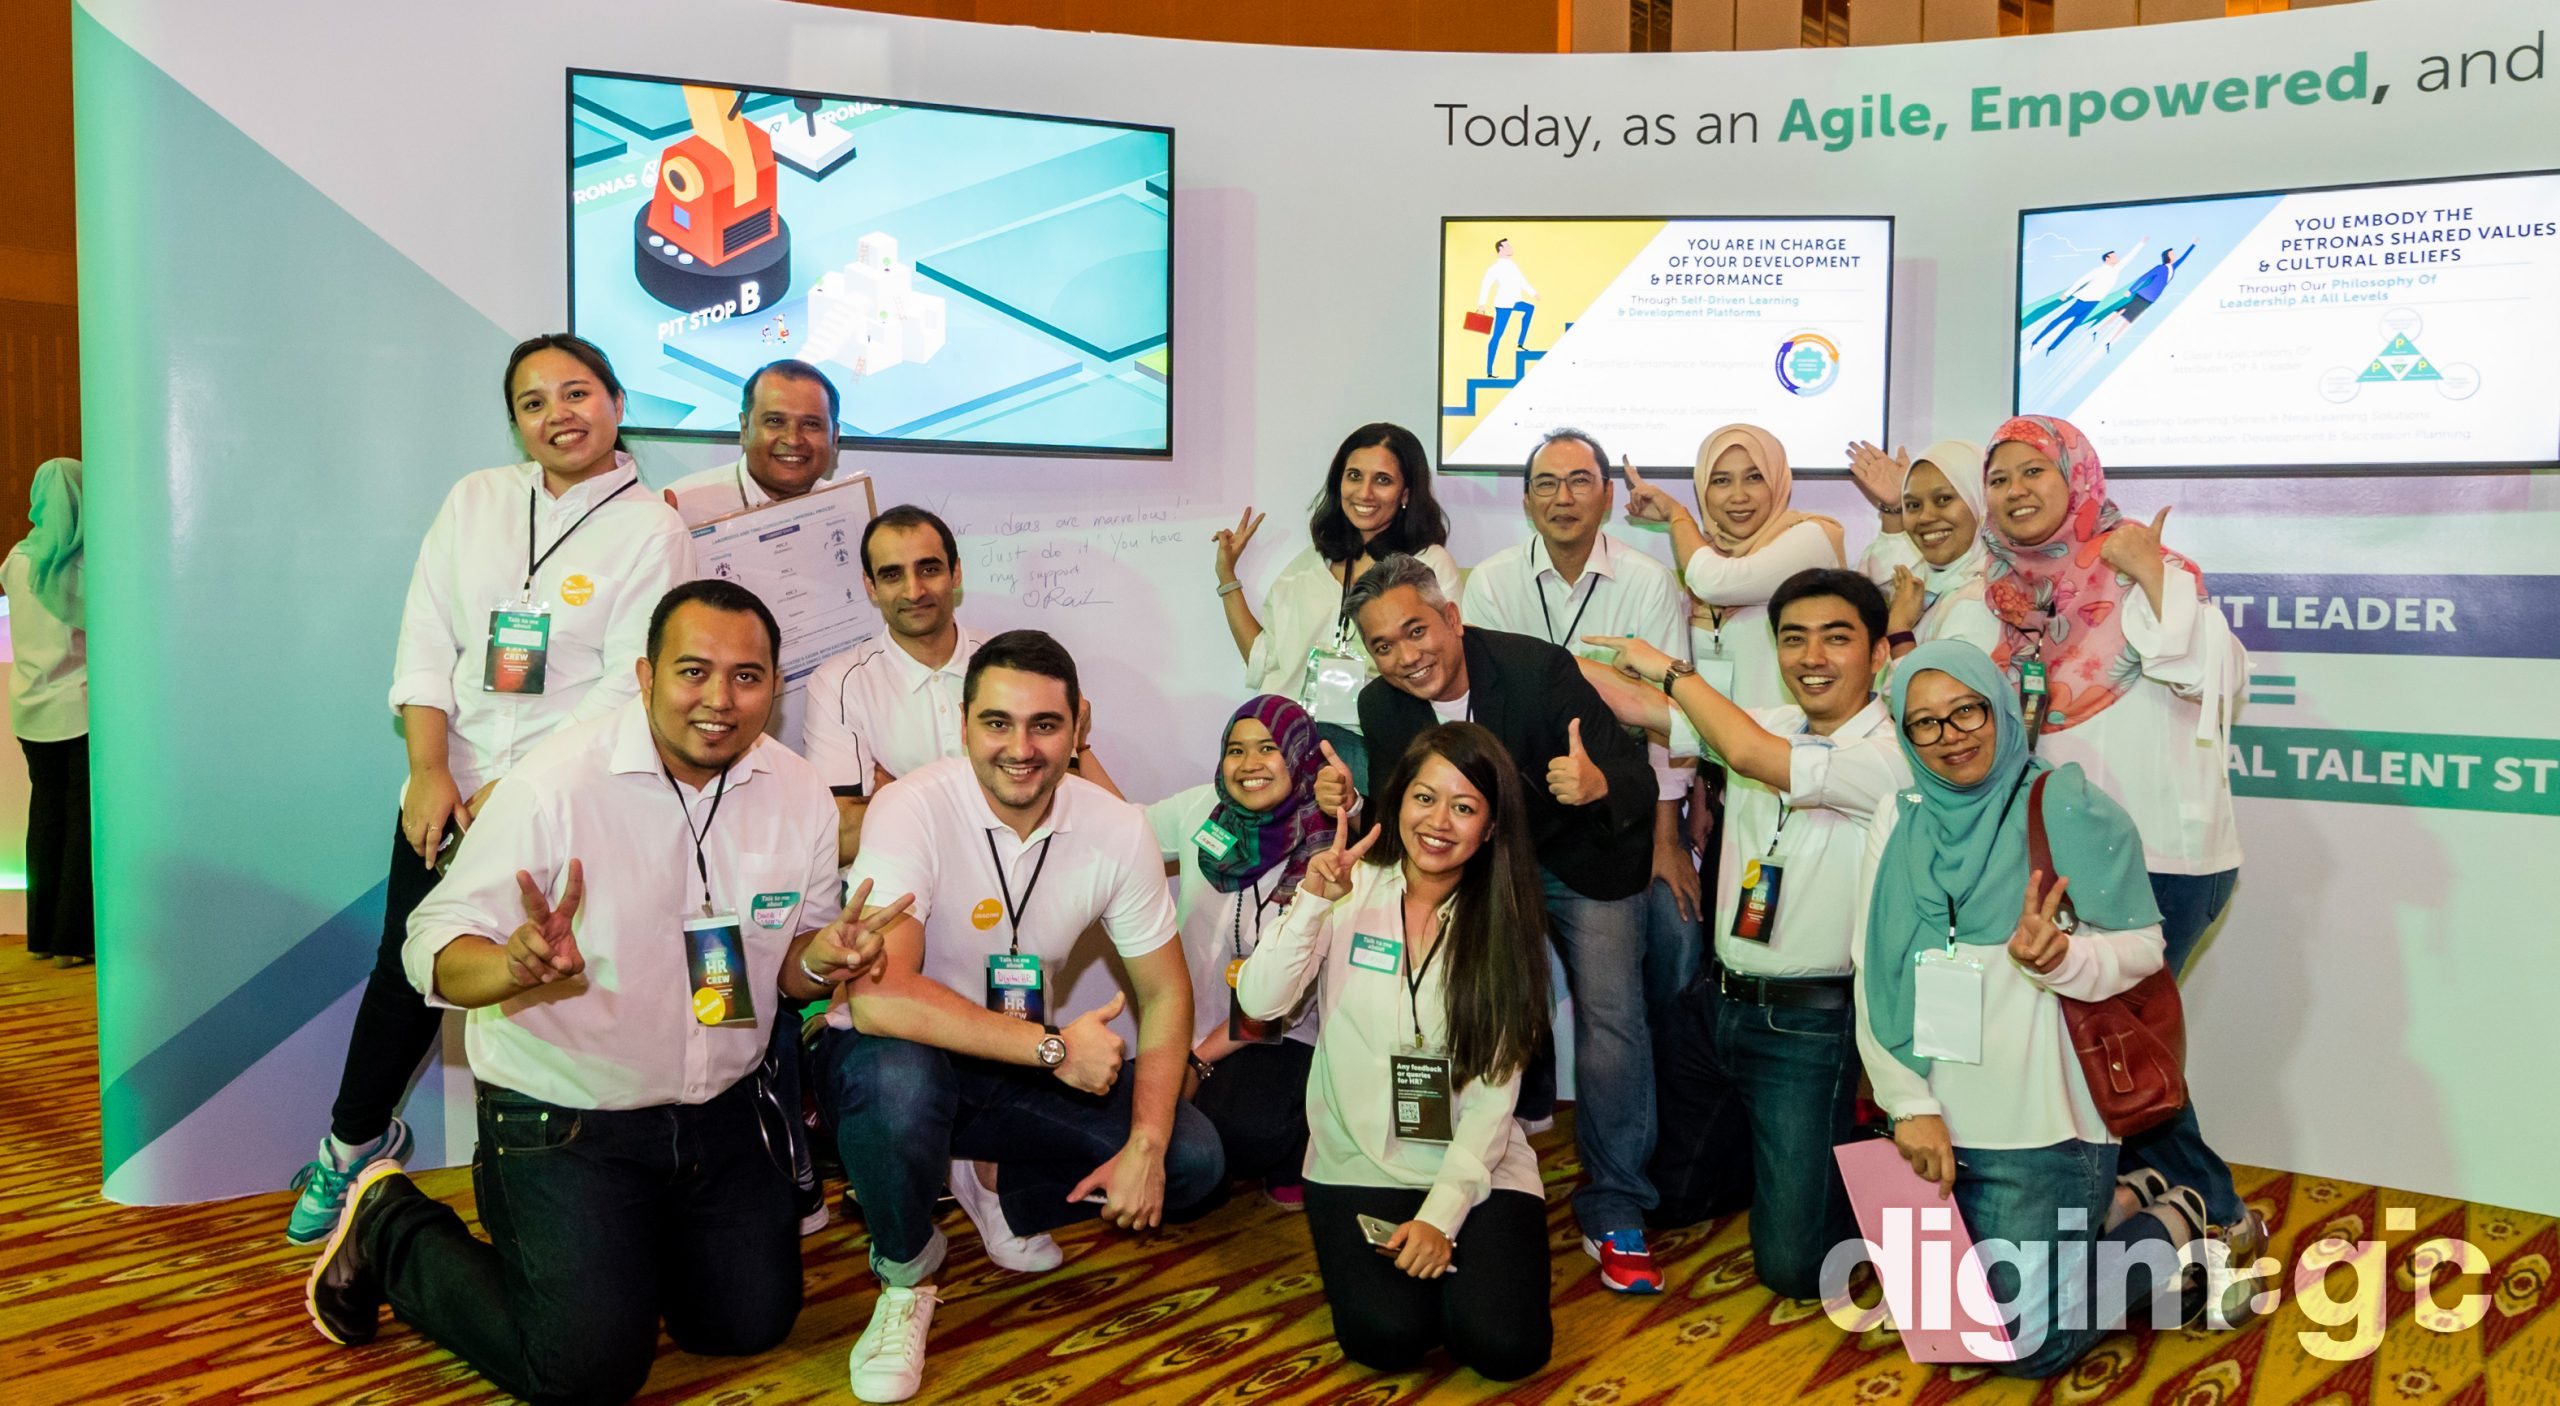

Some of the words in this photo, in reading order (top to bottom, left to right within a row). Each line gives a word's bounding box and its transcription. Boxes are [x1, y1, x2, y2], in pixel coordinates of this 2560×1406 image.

[1434, 103, 1601, 158] Today,
[1622, 113, 1676, 146] as
[1696, 110, 1758, 145] an
[1777, 93, 1948, 152] Agile,
[1970, 50, 2390, 138] Empowered,
[2416, 30, 2545, 93] and
[2295, 217, 2336, 232] YOU
[2343, 210, 2428, 229] EMBODY
[2434, 207, 2474, 222] THE
[2281, 233, 2385, 252] PETRONAS
[2391, 228, 2471, 246] SHARED
[2477, 222, 2557, 240] VALUES
[1687, 239, 1720, 250] YOU
[1725, 239, 1754, 250] ARE
[1760, 239, 1775, 250] IN
[1780, 239, 1846, 250] CHARGE
[1668, 256, 1689, 268] OF
[1693, 256, 1738, 268] YOUR
[1743, 256, 1860, 268] DEVELOPMENT
[2259, 260, 2270, 272] &
[2276, 253, 2378, 271] CULTURAL
[2385, 248, 2462, 265] BELIEFS
[1650, 274, 1660, 285] &
[1666, 274, 1783, 285] PERFORMANCE
[2239, 282, 2296, 295] Through
[2300, 281, 2327, 292] Our
[2332, 277, 2414, 290] Philosophy
[2418, 274, 2437, 285] Of
[1631, 295, 1678, 307] Through
[1681, 295, 1745, 305] Self-Driven
[1749, 295, 1799, 307] Learning
[2219, 296, 2297, 309] Leadership
[2300, 294, 2316, 305] At
[2320, 292, 2339, 304] All
[2343, 290, 2389, 303] Levels
[658, 317, 687, 341] PIT
[688, 301, 737, 330] STOP
[740, 280, 761, 314] B
[1618, 308, 1624, 317] &
[1629, 308, 1703, 318] Development
[1706, 308, 1762, 317] Platforms
[2395, 338, 2405, 349] P
[2371, 361, 2381, 373] P
[2418, 360, 2428, 371] P
[2415, 429, 2472, 442] Planning
[979, 539, 1027, 568] Just
[1150, 530, 1184, 545] have
[989, 571, 1019, 593] my
[1030, 565, 1080, 590] support
[2267, 596, 2458, 633] LEADER
[503, 653, 529, 661] CREW
[2287, 746, 2482, 789] TALENT
[2493, 757, 2559, 794] ST
[705, 960, 728, 975] HR
[706, 975, 731, 985] CREW
[1004, 997, 1026, 1011] HR
[1397, 1063, 1410, 1072] Any
[1411, 1064, 1442, 1073] feedback
[1406, 1072, 1431, 1080] queries
